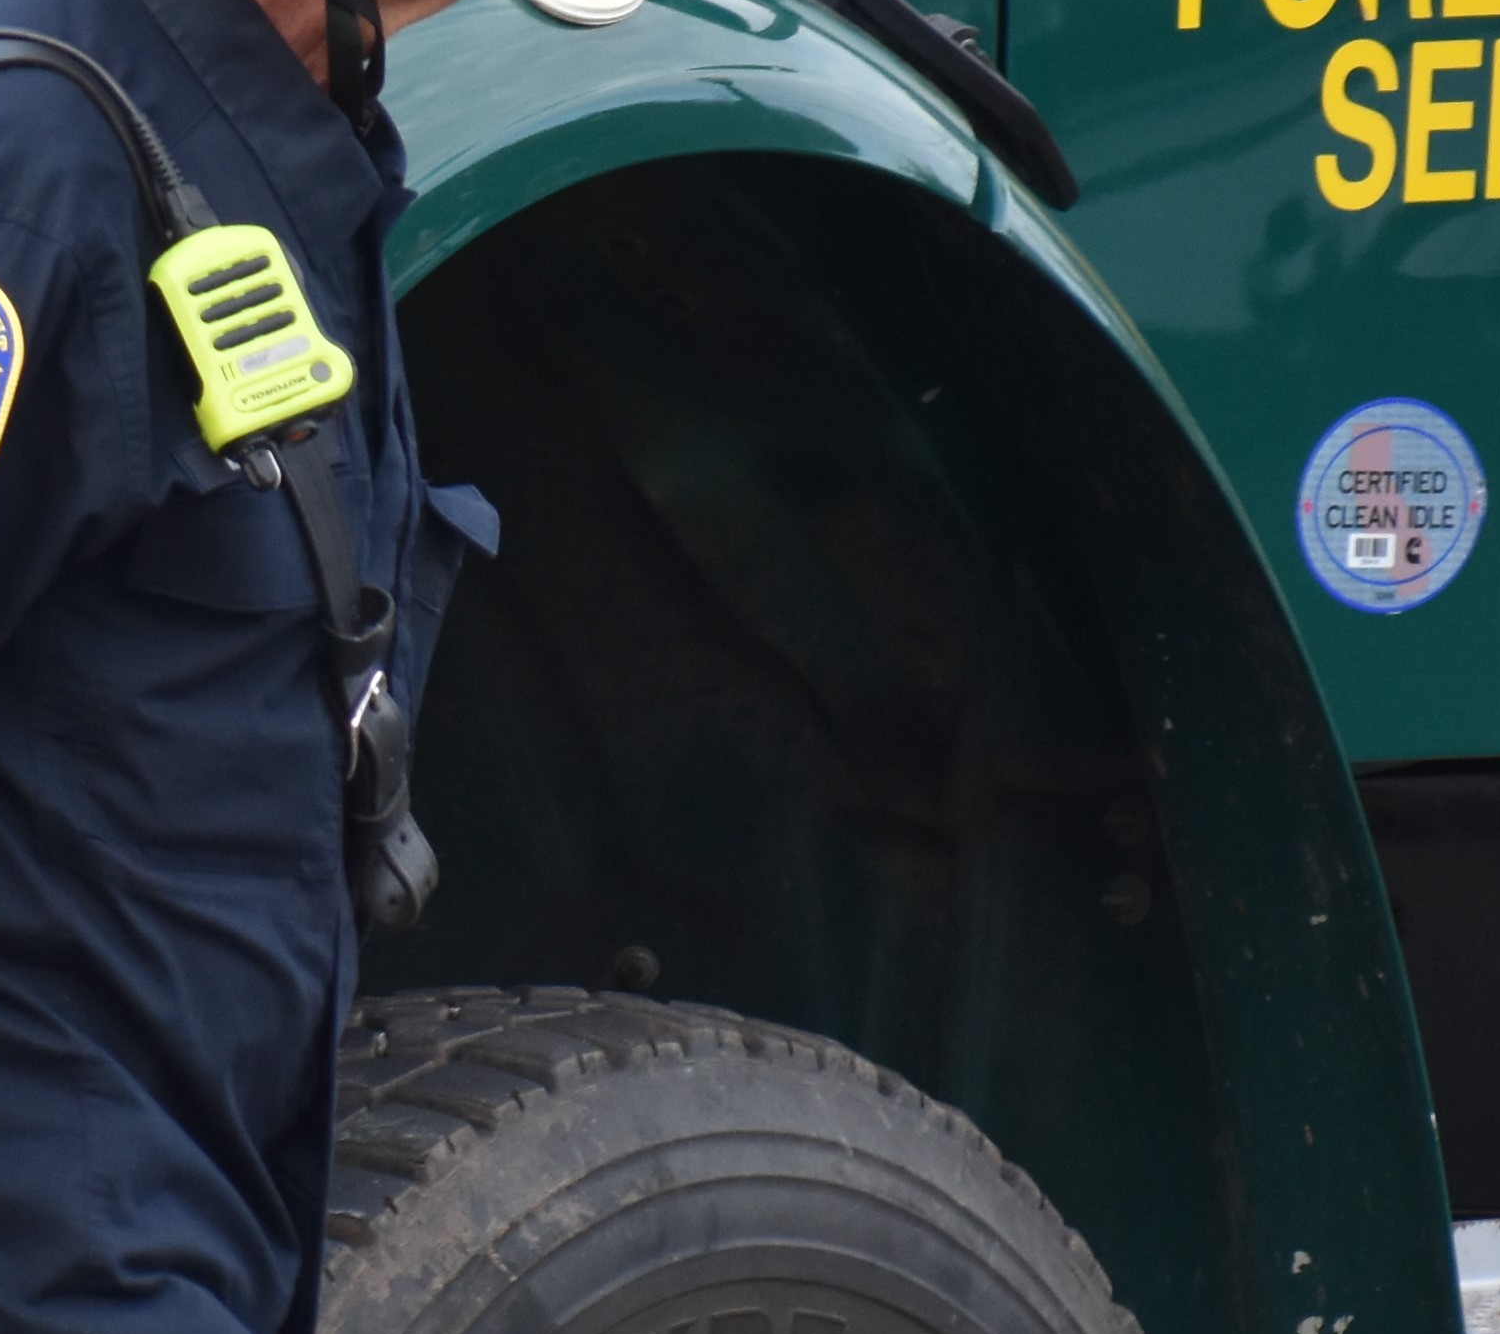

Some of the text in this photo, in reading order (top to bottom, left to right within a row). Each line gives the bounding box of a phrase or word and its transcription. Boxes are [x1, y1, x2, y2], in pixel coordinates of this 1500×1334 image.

[1338, 470, 1448, 495] CERTIFIED
[1325, 505, 1456, 530] CLEAN IDLE
